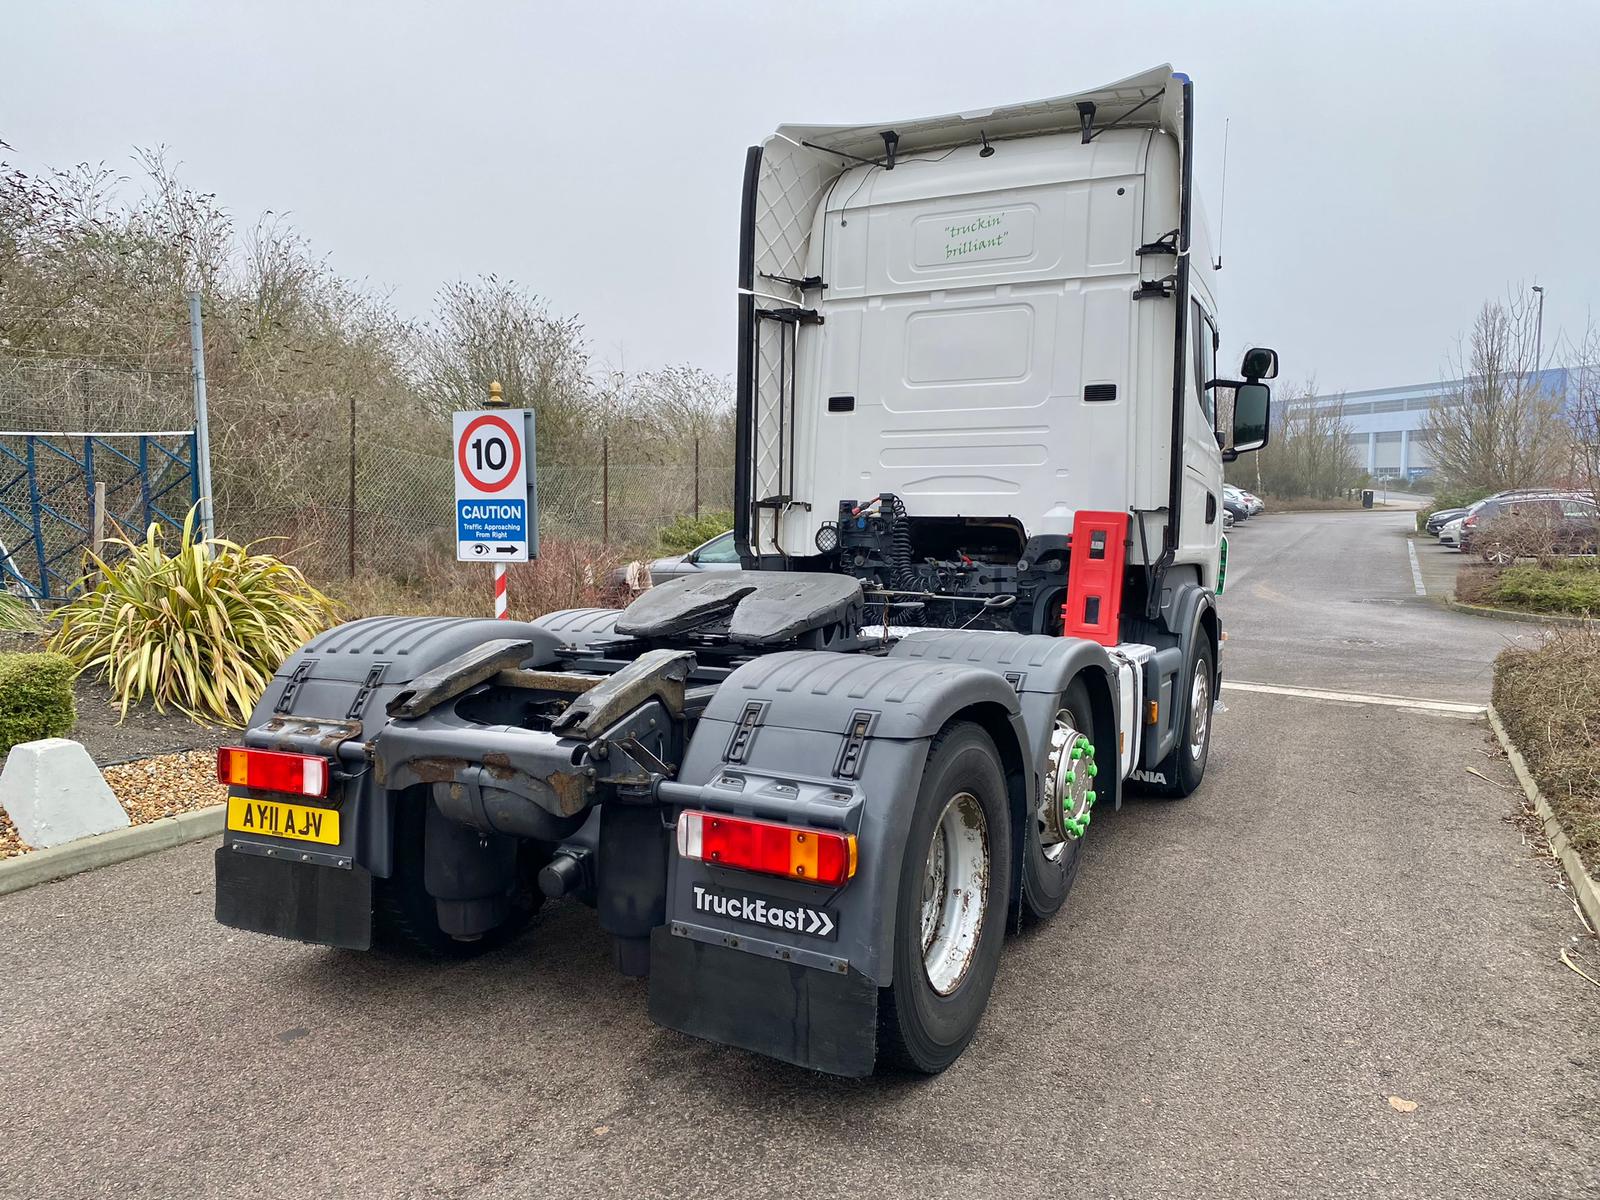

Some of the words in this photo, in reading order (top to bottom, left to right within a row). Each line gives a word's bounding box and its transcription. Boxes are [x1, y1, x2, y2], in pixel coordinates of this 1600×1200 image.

[471, 437, 507, 471] 10
[462, 505, 521, 519] CAUTION
[484, 523, 520, 531] Approaching
[491, 531, 508, 539] Right
[284, 809, 322, 838] AJV
[693, 886, 805, 931] TruckEast
